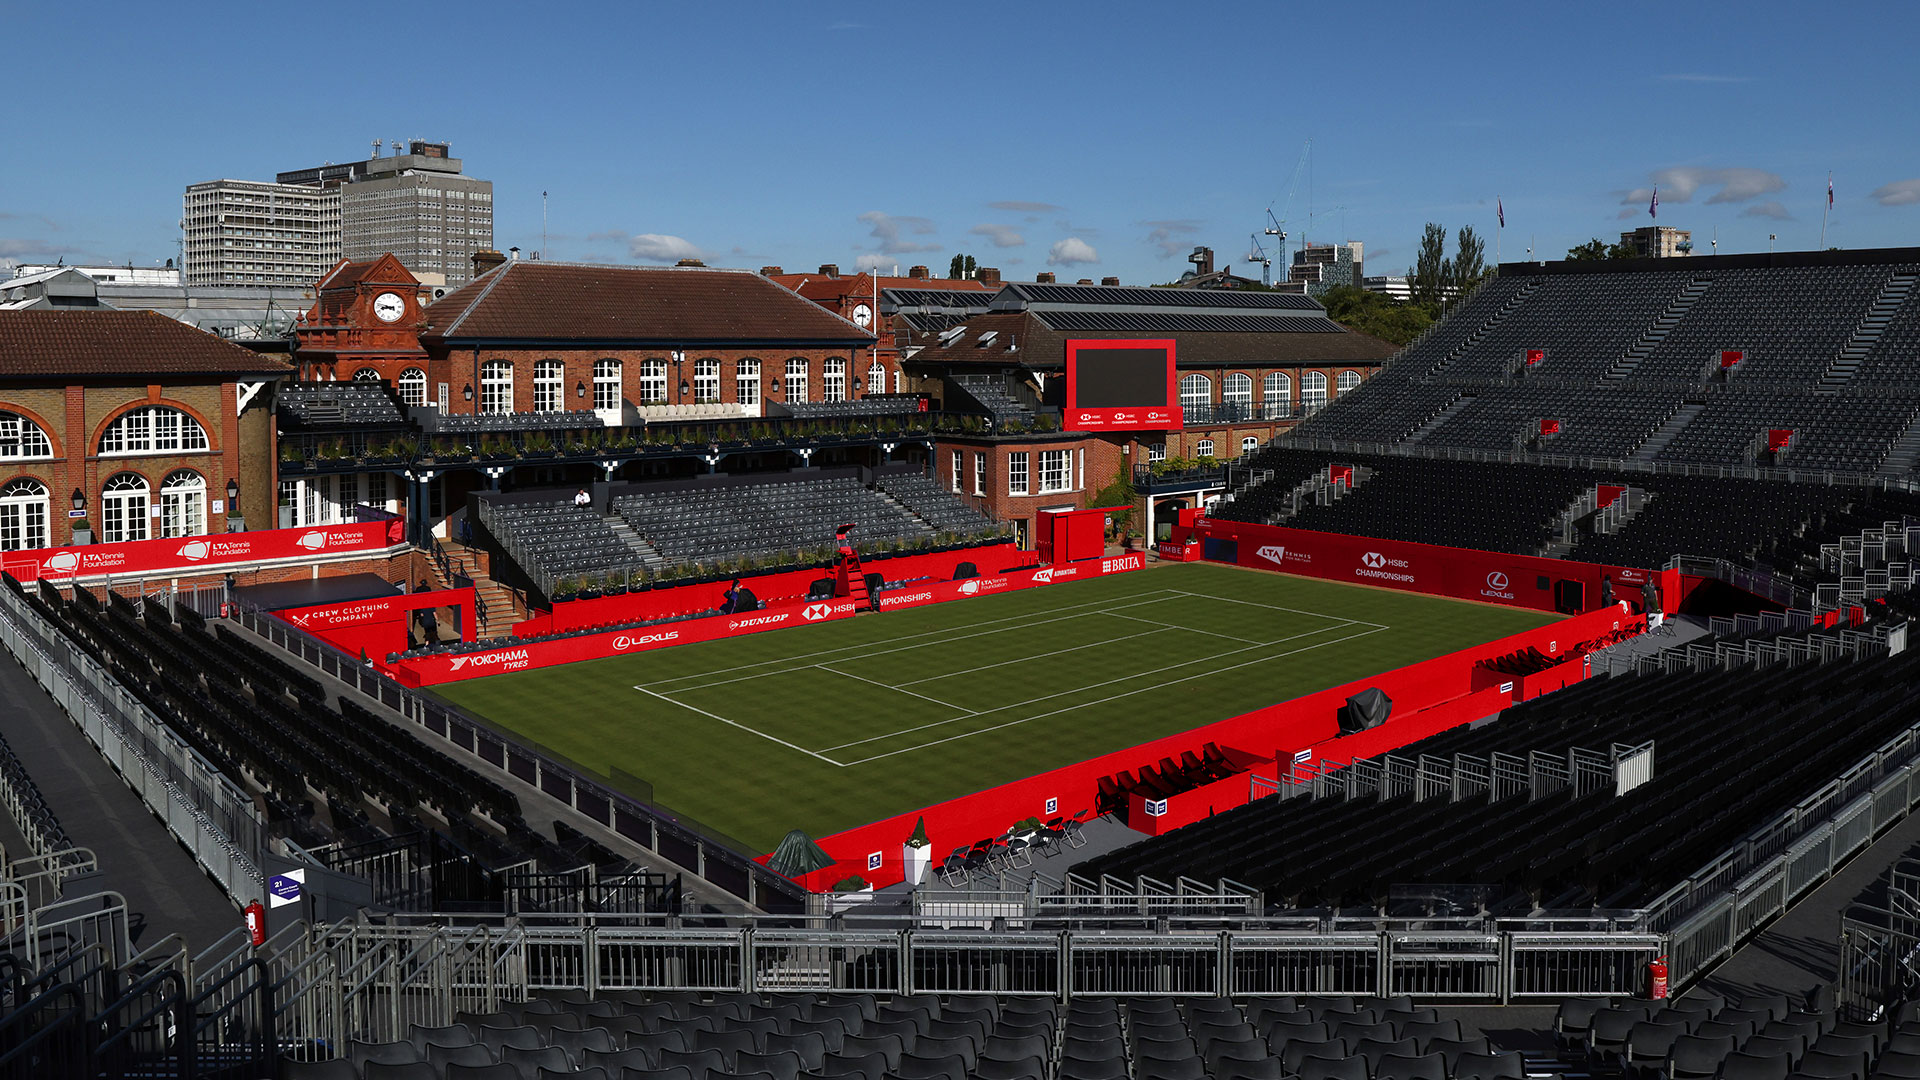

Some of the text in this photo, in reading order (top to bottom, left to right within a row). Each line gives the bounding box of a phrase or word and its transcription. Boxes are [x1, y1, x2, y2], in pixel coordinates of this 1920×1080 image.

[343, 531, 364, 539] Tennis
[229, 541, 250, 549] Tennis
[328, 538, 364, 546] Foundation
[101, 552, 125, 560] Tennis
[212, 548, 251, 557] Foundation
[1261, 548, 1281, 560] LTA
[1285, 551, 1311, 559] TENNIS
[83, 559, 125, 568] Foundation
[1112, 556, 1140, 571] BRITA
[1388, 559, 1409, 568] HSBC
[1036, 568, 1077, 580] LTA ADVANTAGE
[1355, 568, 1415, 583] CHAMPIONSHIPS
[981, 582, 1008, 590] Foundation
[1480, 589, 1514, 599] LEXUS
[312, 602, 390, 619] CREW CLOTHING
[329, 612, 374, 624] COMPANY
[739, 613, 789, 628] DUNLOP
[631, 630, 679, 645] LEXUS
[469, 649, 529, 667] YOKOHAMA
[503, 659, 529, 670] TYRES
